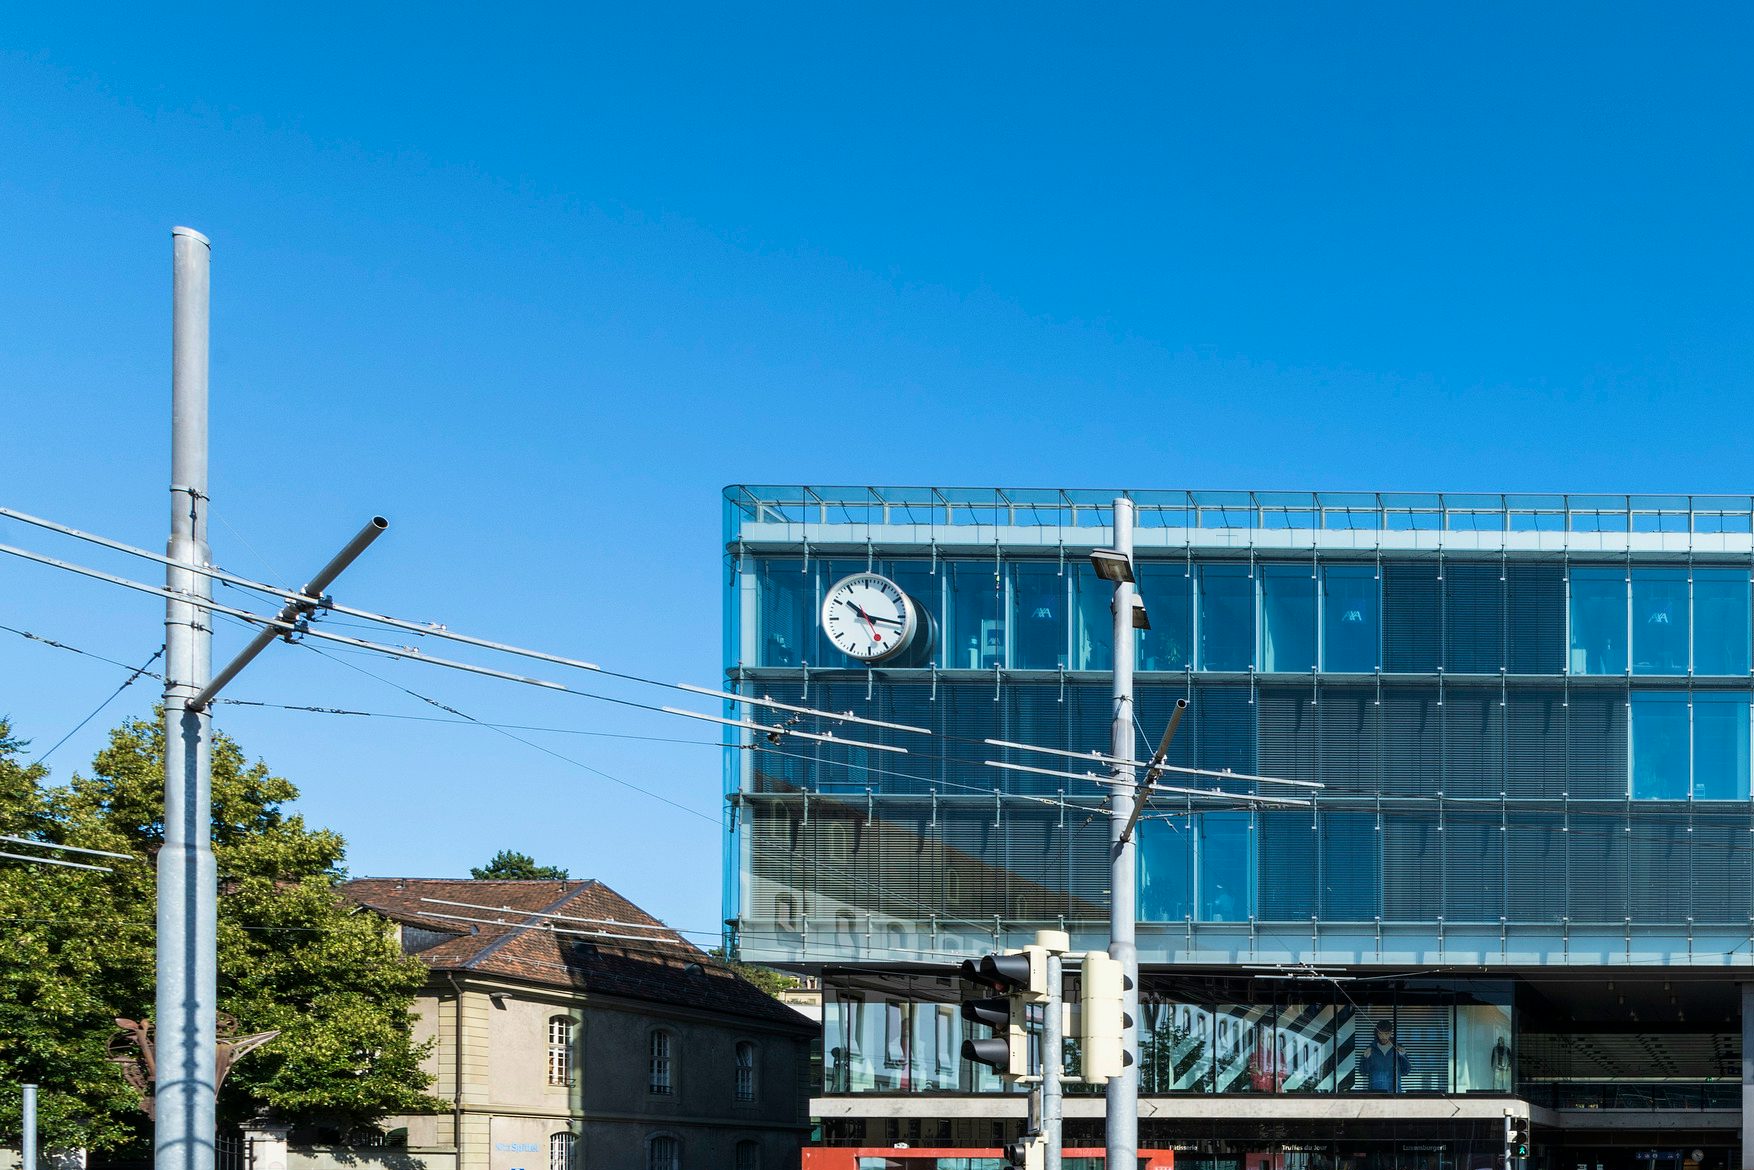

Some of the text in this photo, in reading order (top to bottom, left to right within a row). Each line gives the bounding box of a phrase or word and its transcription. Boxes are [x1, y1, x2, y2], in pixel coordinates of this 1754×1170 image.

[1031, 607, 1052, 618] AXA
[1342, 610, 1362, 621] AXA
[1648, 612, 1668, 623] AXA
